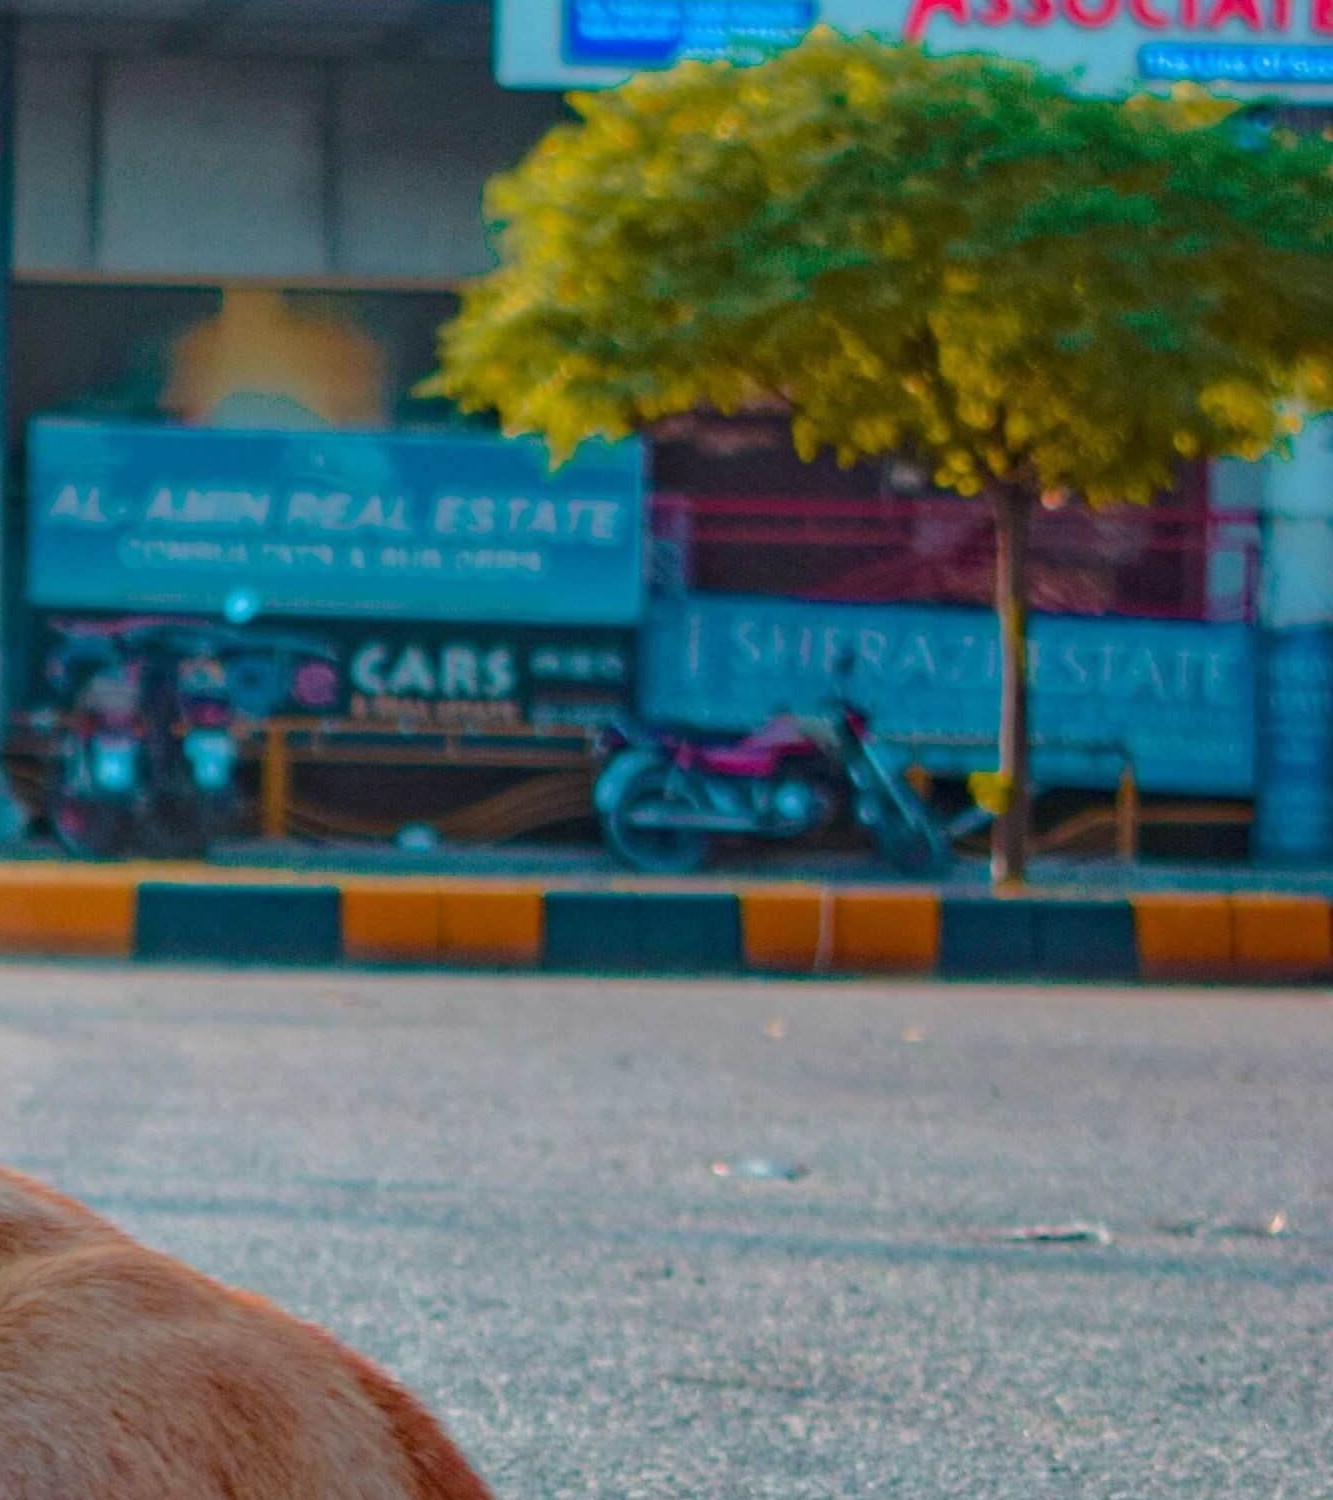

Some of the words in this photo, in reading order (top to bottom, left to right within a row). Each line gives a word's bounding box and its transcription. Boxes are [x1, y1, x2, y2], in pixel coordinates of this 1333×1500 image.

[287, 493, 409, 531] REAL
[433, 496, 620, 539] ESTATE
[350, 641, 517, 698] CARS
